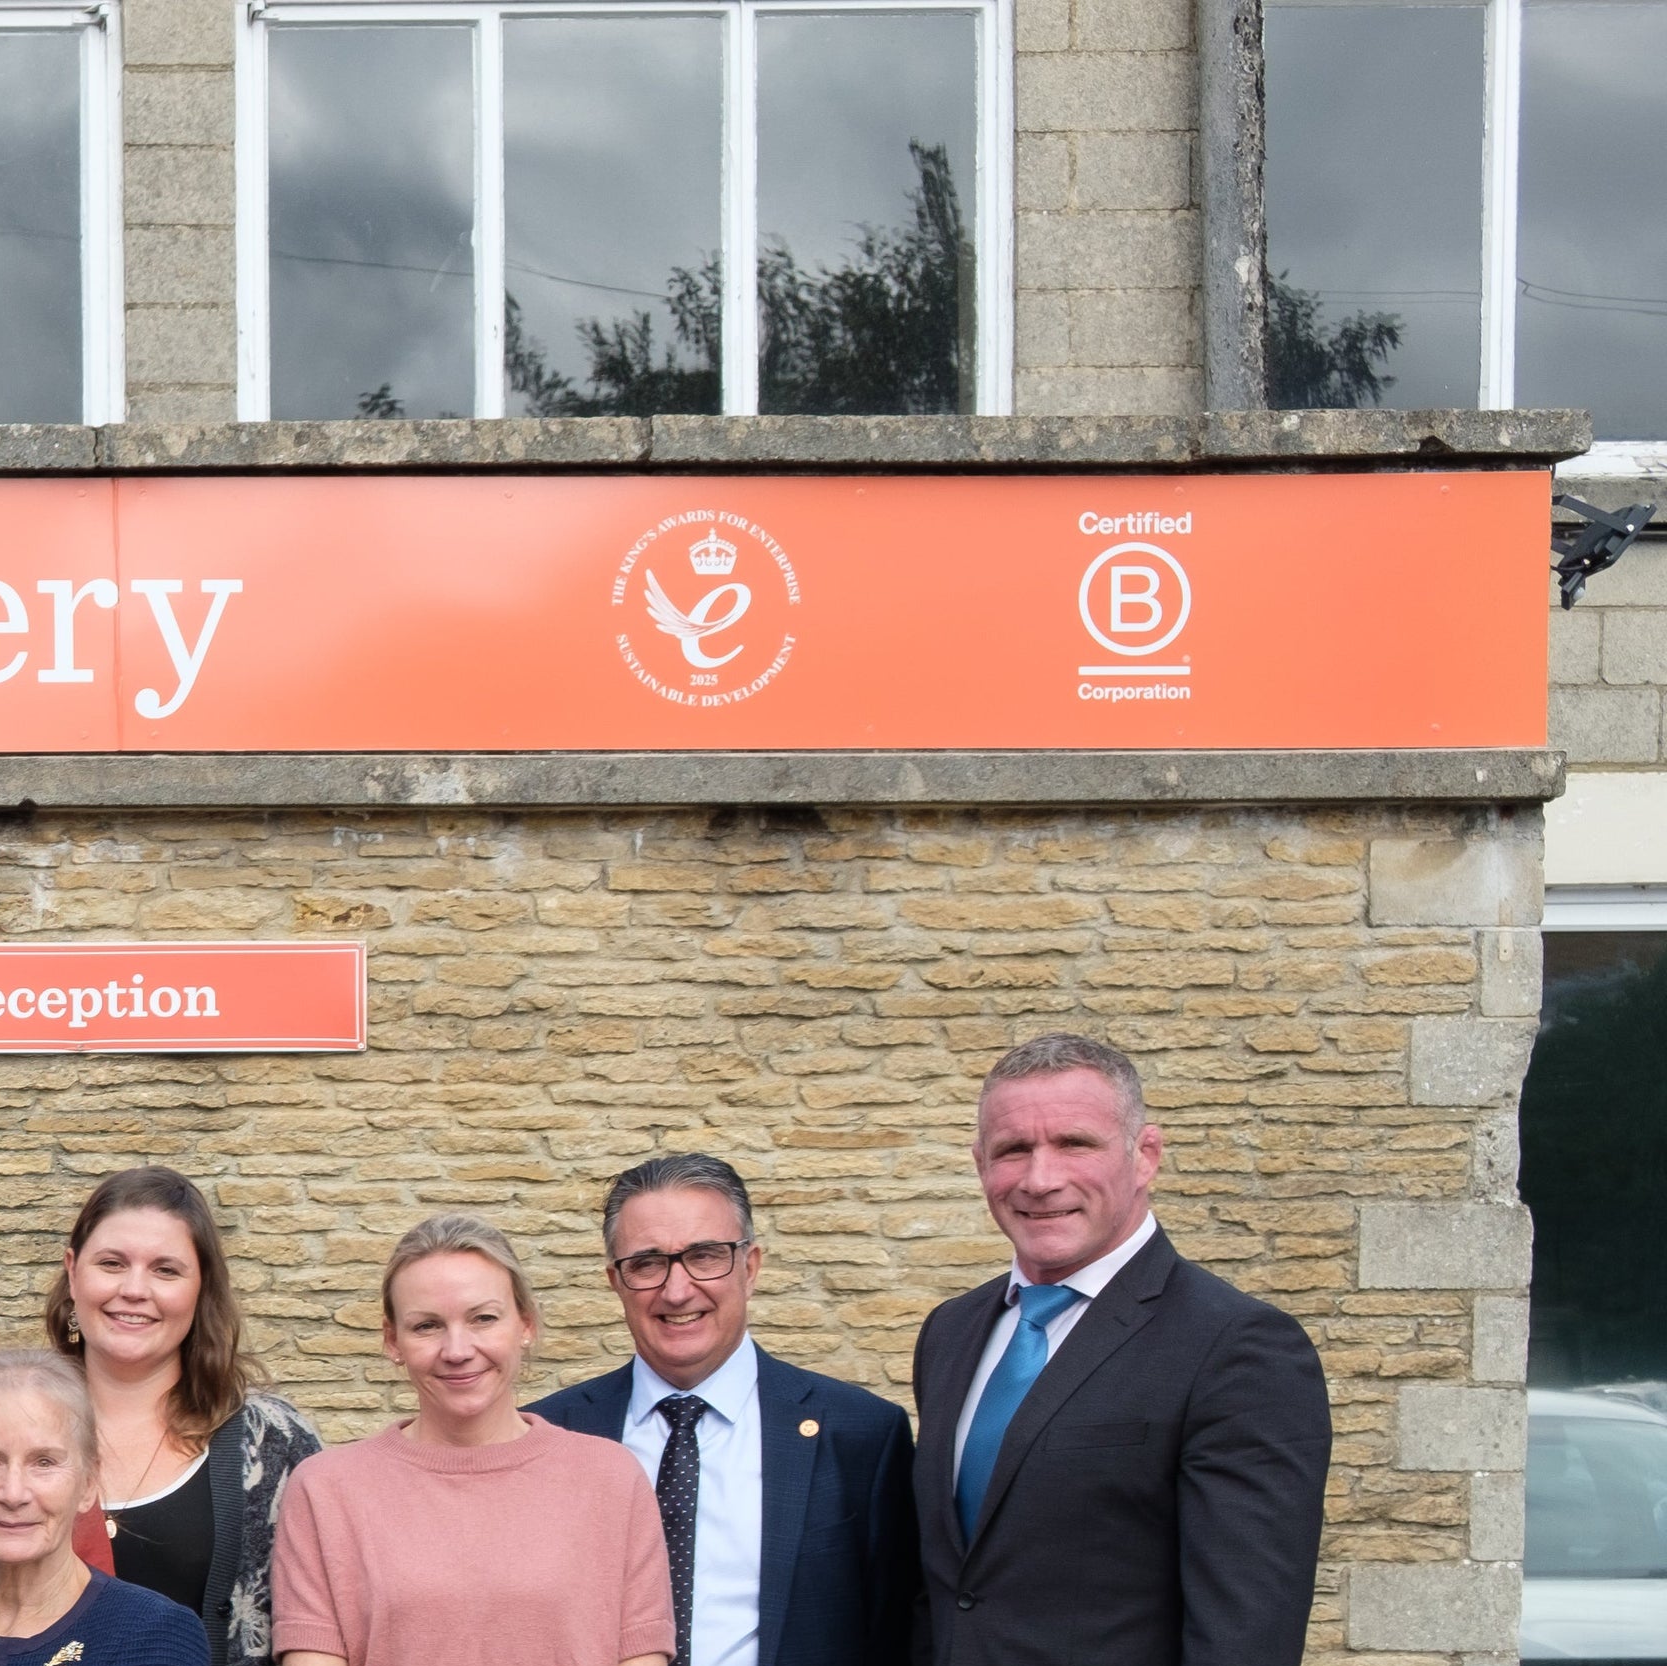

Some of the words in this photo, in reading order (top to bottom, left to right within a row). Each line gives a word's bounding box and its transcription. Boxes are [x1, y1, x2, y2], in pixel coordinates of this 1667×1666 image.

[1078, 511, 1192, 535] Certified
[612, 575, 627, 606] THE
[620, 529, 658, 574] KING'S
[657, 509, 716, 533] AWARDS
[718, 511, 749, 531] FOR
[749, 524, 802, 606] ENTERPRISE
[1110, 566, 1163, 633] B
[616, 634, 698, 706] SUSTAINABLE
[701, 633, 797, 707] DEVELOPMENT
[690, 674, 718, 686] 2025
[1077, 683, 1191, 703] Corporation
